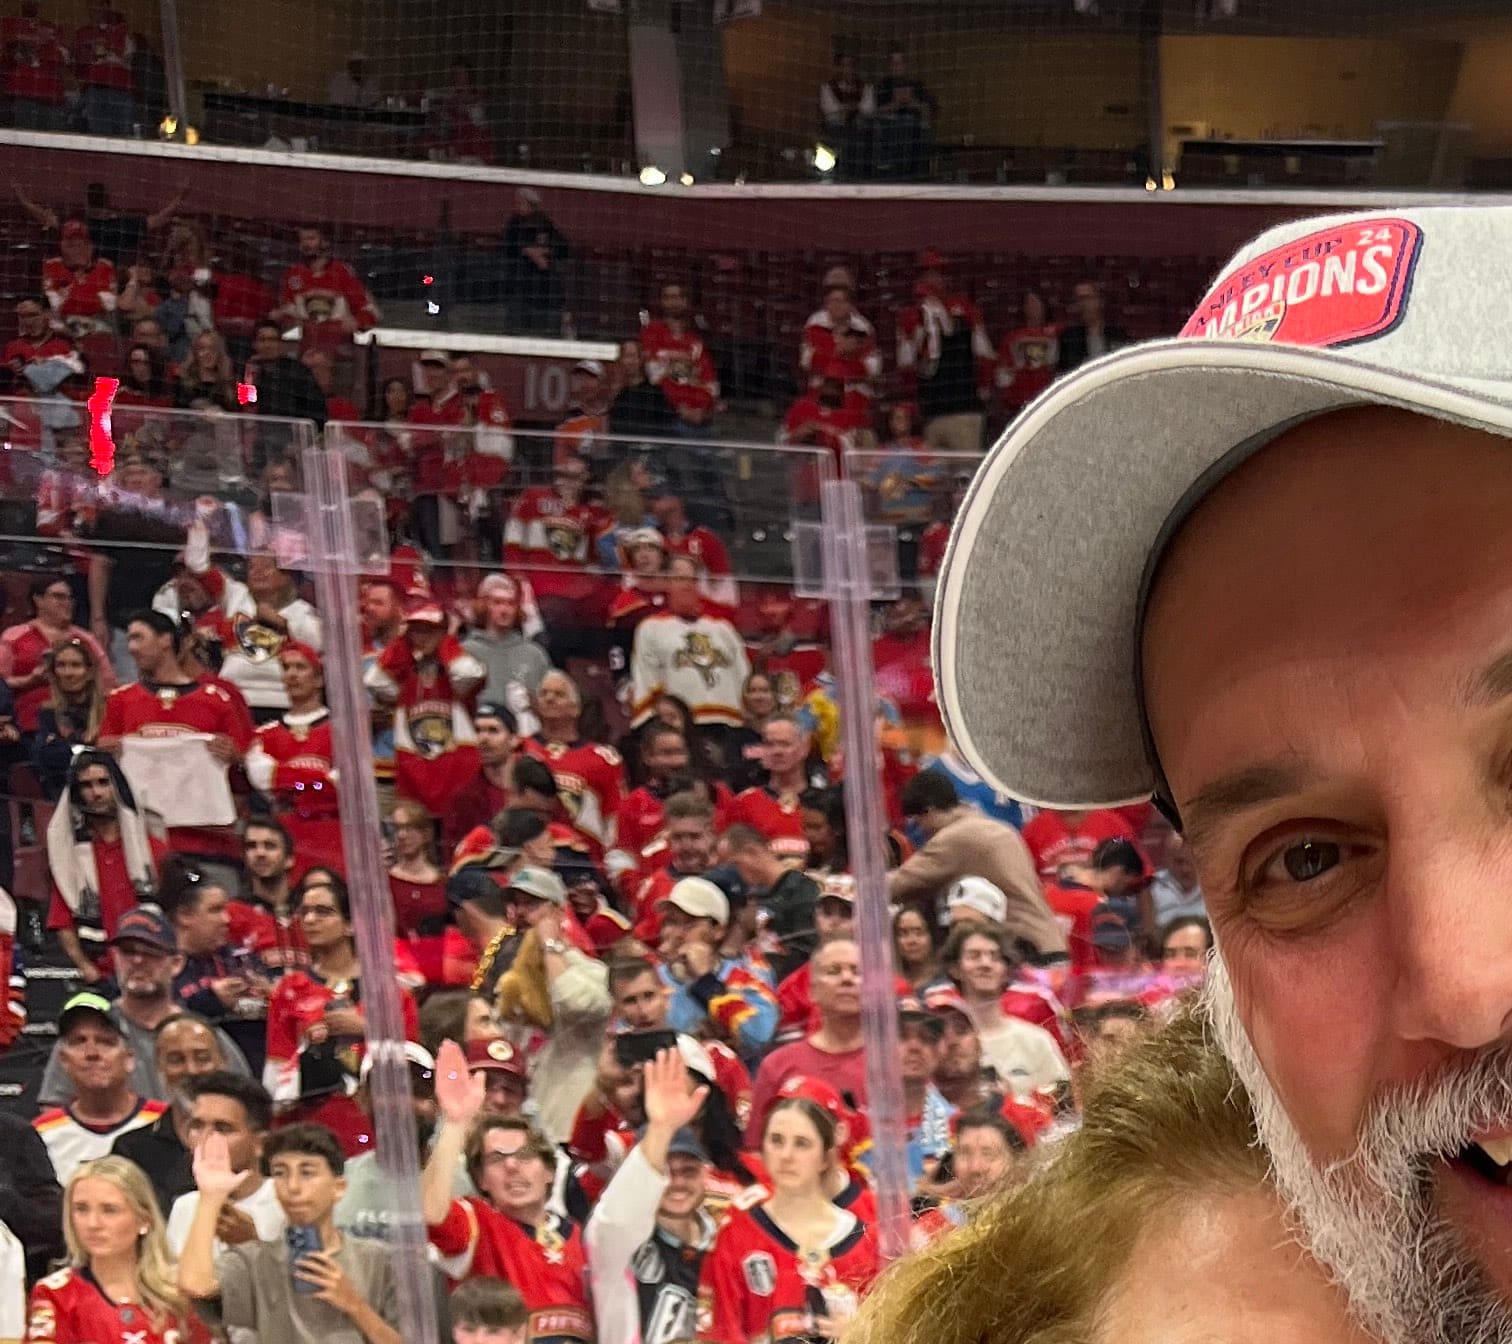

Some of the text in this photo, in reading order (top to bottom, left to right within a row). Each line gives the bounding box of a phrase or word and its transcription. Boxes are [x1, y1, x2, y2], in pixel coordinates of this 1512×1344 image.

[1357, 227, 1393, 246] 24
[1196, 237, 1344, 328] ANLEY CUP
[1204, 243, 1394, 340] MPIONS
